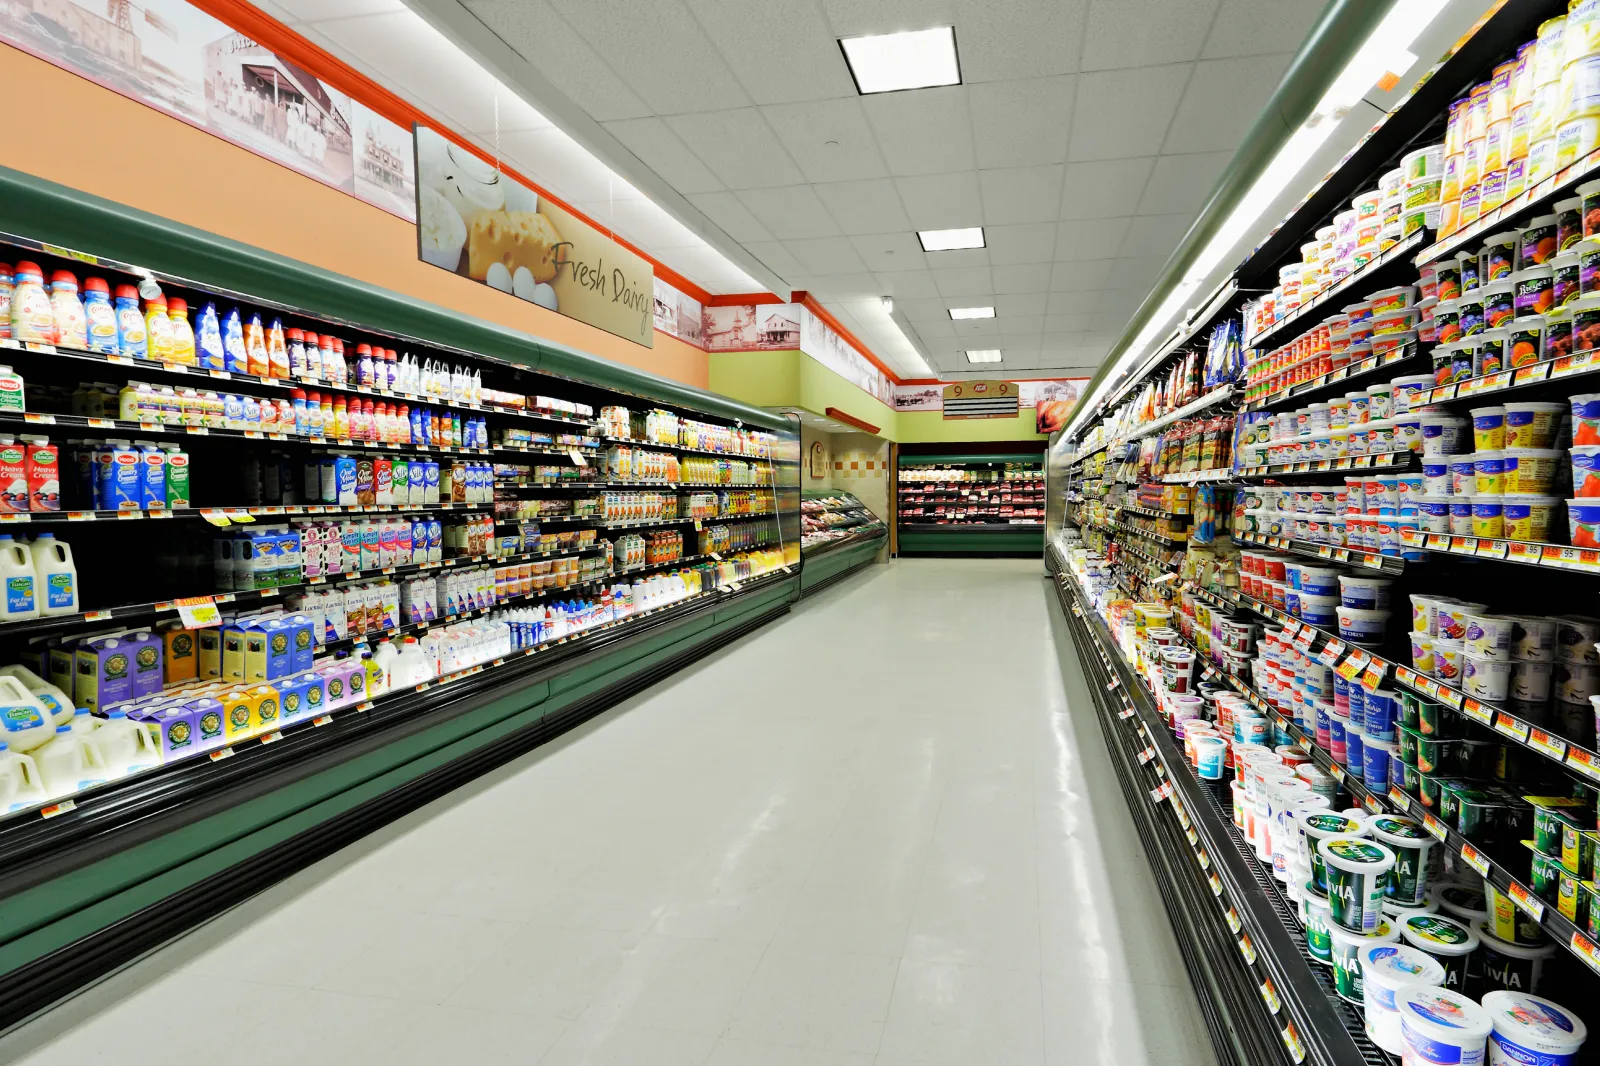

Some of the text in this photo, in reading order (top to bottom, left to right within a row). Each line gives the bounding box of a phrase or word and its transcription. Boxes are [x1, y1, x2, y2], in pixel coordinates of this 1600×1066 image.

[551, 241, 650, 336] Fresh Dairy
[1518, 278, 1551, 298] Breyers
[954, 386, 962, 397] 9
[1000, 384, 1007, 396] 9
[34, 466, 56, 474] Heavy
[1528, 546, 1538, 554] .95
[1563, 550, 1574, 558] .95
[1584, 550, 1596, 560] 2.53
[1514, 721, 1524, 732] .95
[1550, 738, 1561, 748] .95
[1574, 749, 1587, 762] 2.53
[1512, 884, 1525, 897] 2.99
[1576, 936, 1591, 950] 2.99
[1502, 1044, 1536, 1063] DANNON
